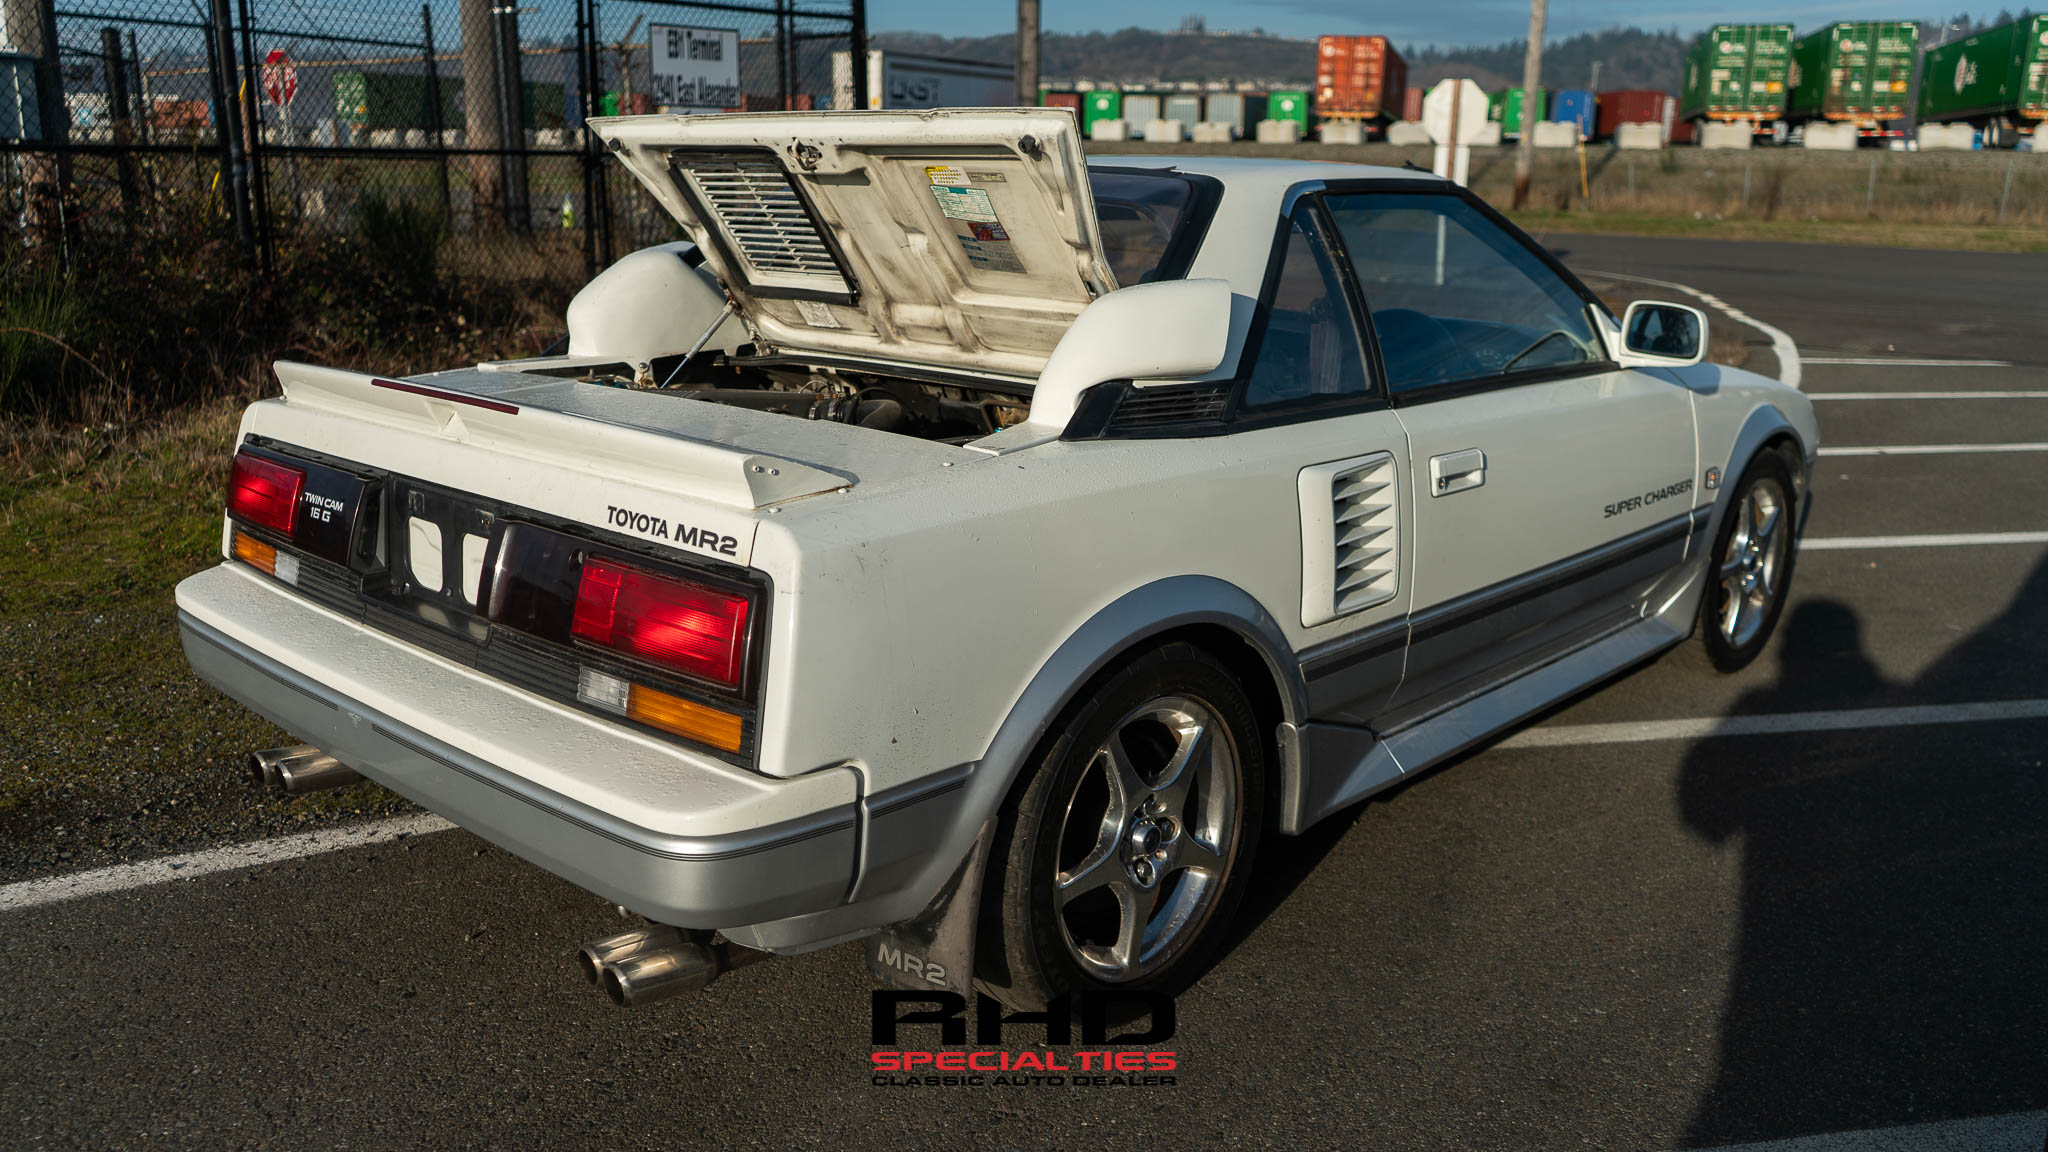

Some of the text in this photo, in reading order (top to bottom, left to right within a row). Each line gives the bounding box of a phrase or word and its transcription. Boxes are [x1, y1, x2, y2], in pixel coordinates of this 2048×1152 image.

[686, 30, 724, 61] Terminal
[677, 73, 696, 105] East
[305, 492, 344, 512] TWIN CAM
[1603, 478, 1694, 519] SUPER CHARGER
[310, 507, 331, 523] 16 G
[607, 504, 739, 558] TOYOTA MR2
[876, 942, 948, 988] MR2
